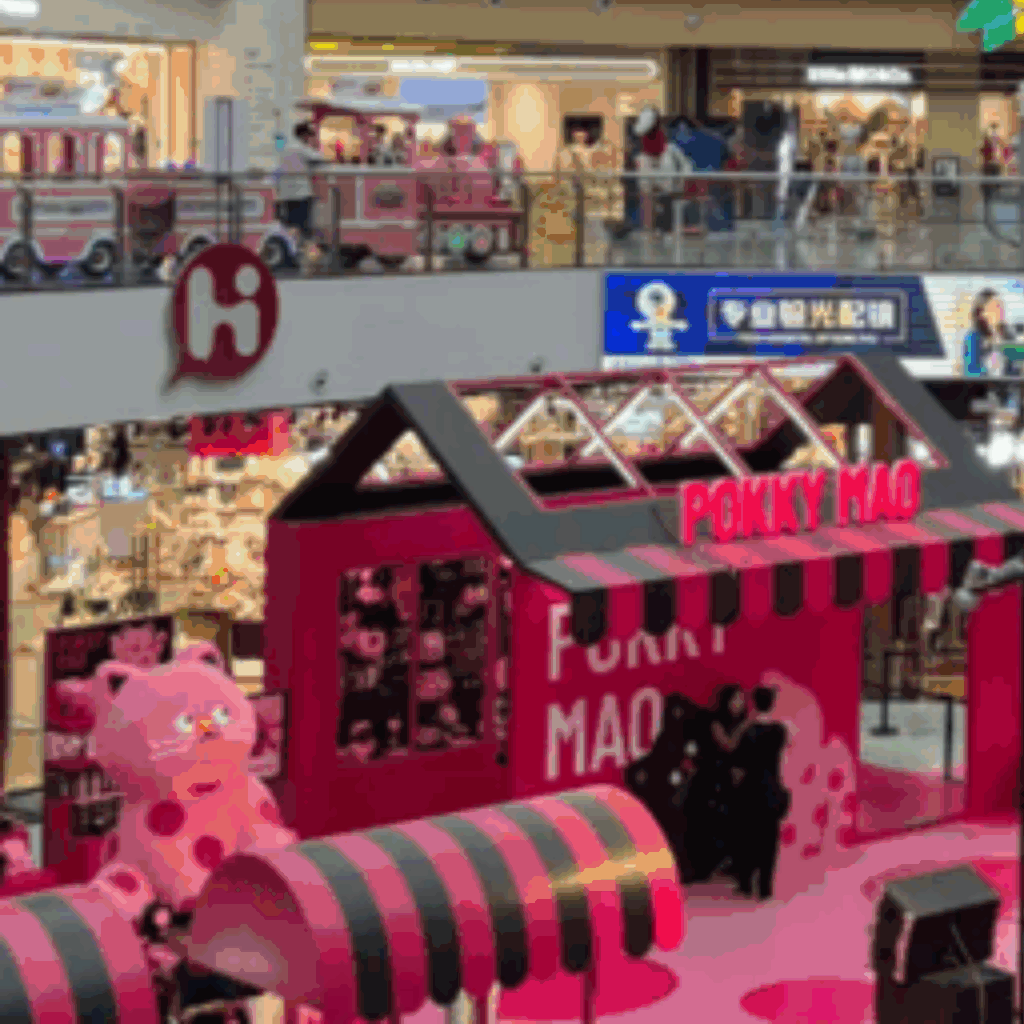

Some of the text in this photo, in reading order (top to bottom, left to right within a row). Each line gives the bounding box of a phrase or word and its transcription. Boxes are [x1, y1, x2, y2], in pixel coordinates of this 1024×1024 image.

[681, 459, 921, 546] POKKY MAO
[546, 687, 664, 780] MAO
